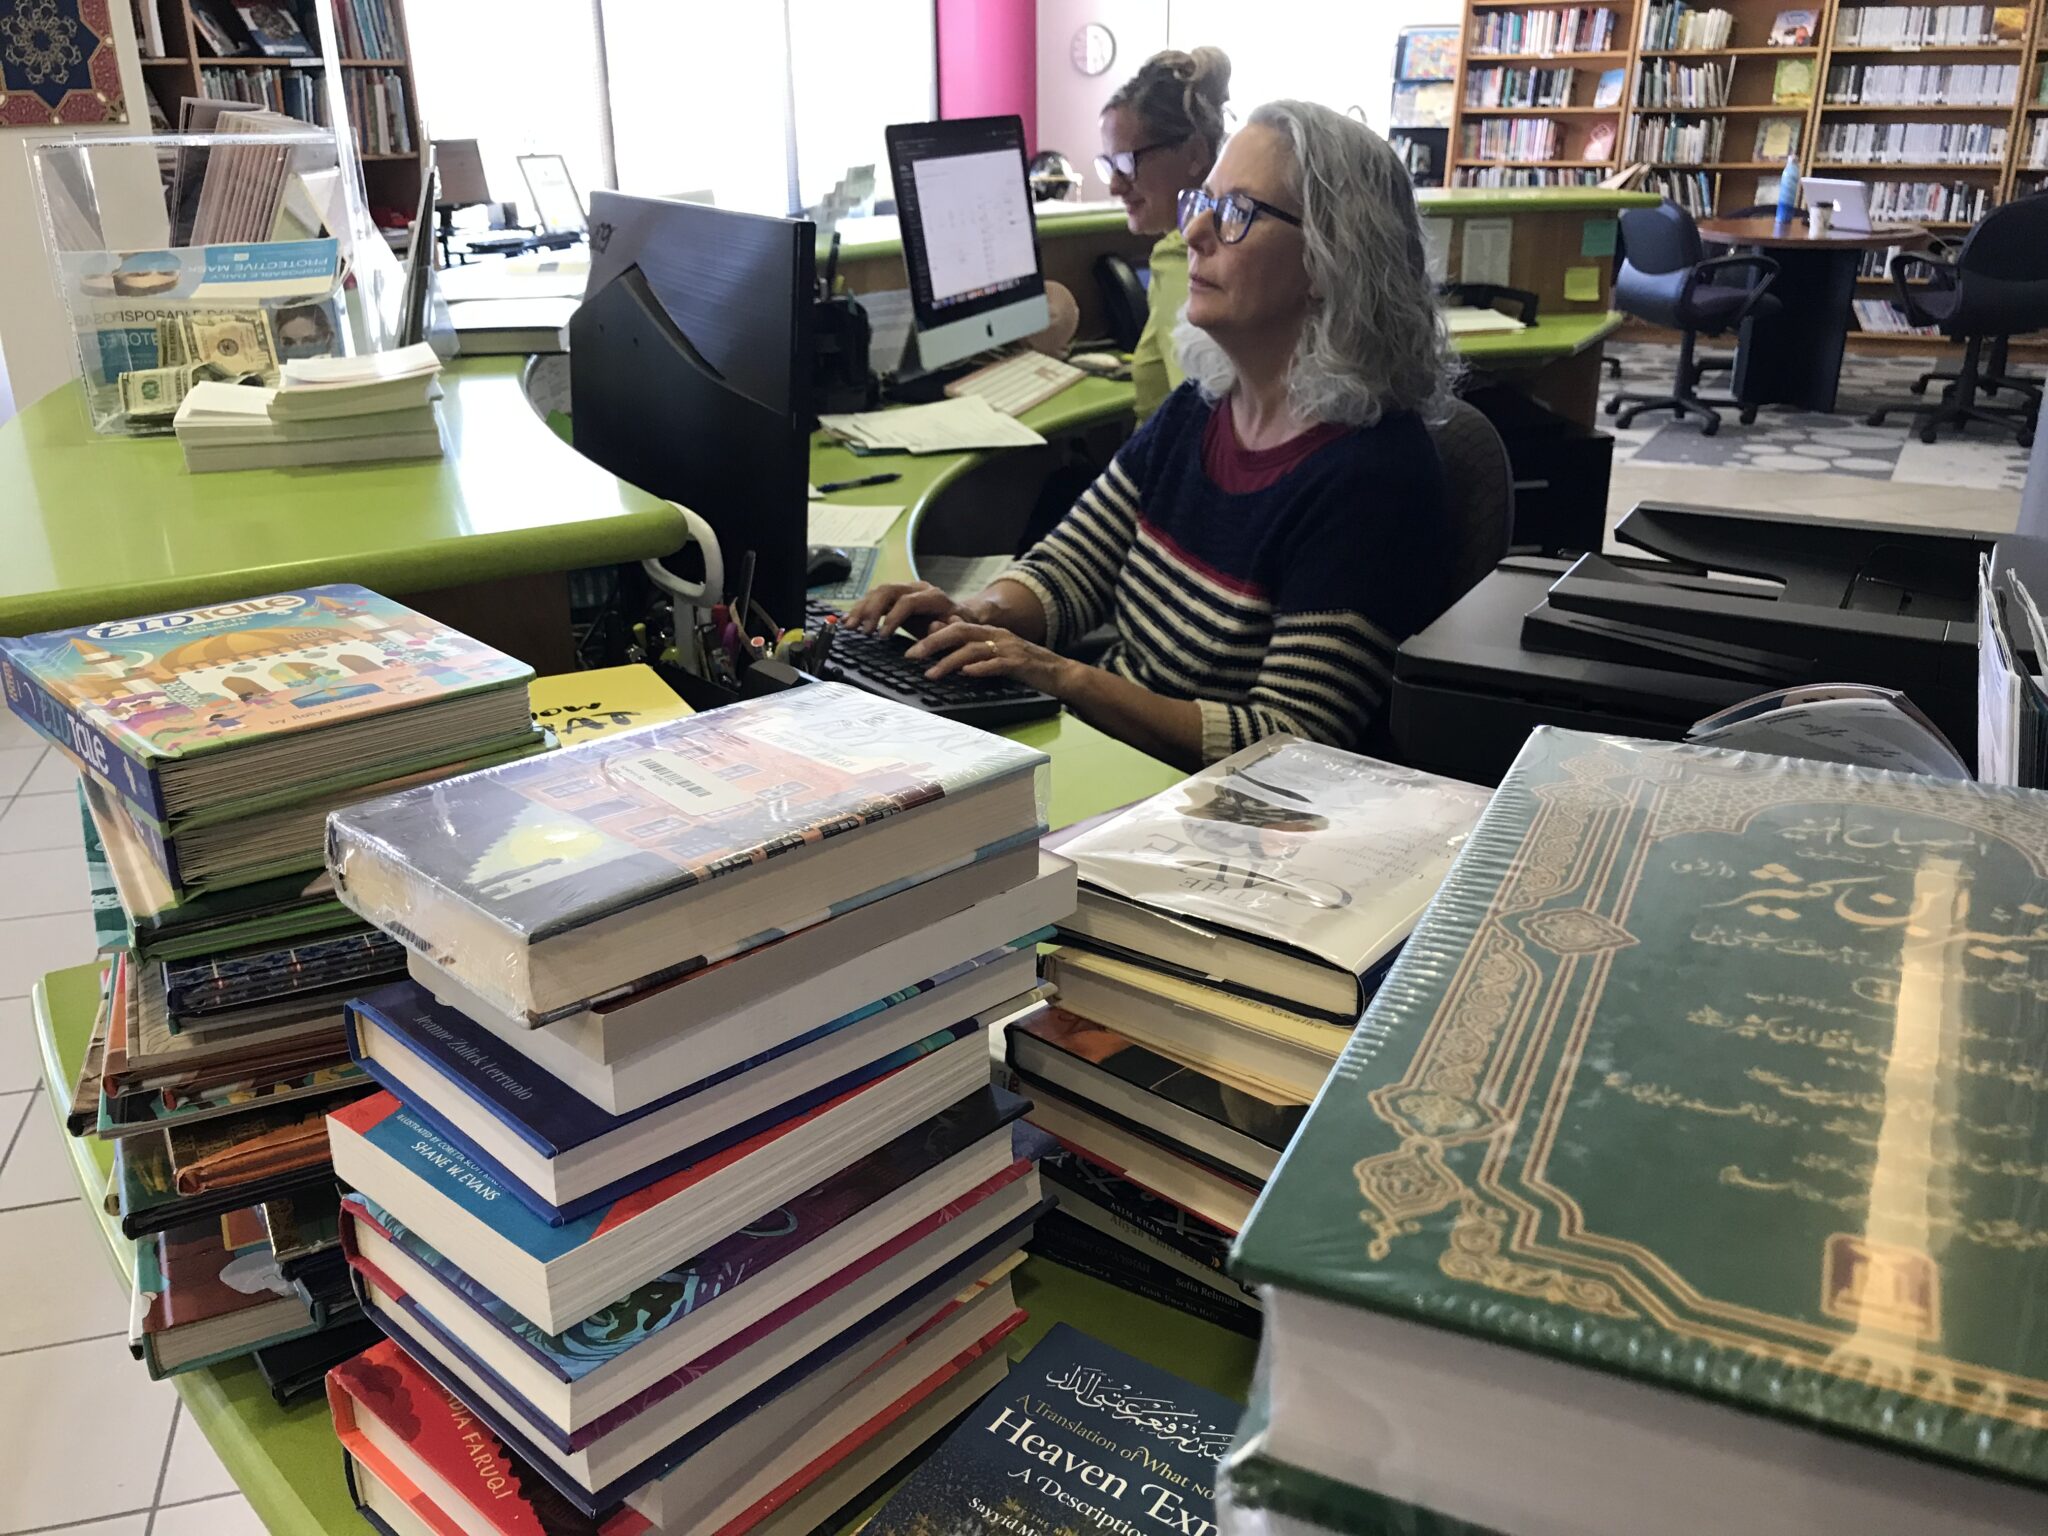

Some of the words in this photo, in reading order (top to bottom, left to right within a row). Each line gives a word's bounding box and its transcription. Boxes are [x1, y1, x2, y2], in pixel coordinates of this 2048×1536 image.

[234, 257, 328, 272] PROTECTIVE
[413, 1014, 453, 1041] Jeanne
[448, 1038, 488, 1067] Zulick
[395, 1113, 433, 1139] ILLUSTRATED
[410, 1140, 453, 1169] SHANE
[445, 1163, 465, 1179] W.
[458, 1172, 502, 1202] EVANS
[1175, 1275, 1199, 1296] Sofia
[1200, 1286, 1241, 1310] Rehman
[985, 1406, 1129, 1501] Heaven
[1016, 1394, 1036, 1416] A
[1035, 1400, 1118, 1453] Translation
[1138, 1447, 1191, 1488] What
[461, 1431, 514, 1500] FARUQI
[1007, 1467, 1034, 1485] A
[968, 1496, 1018, 1530] Sayyid
